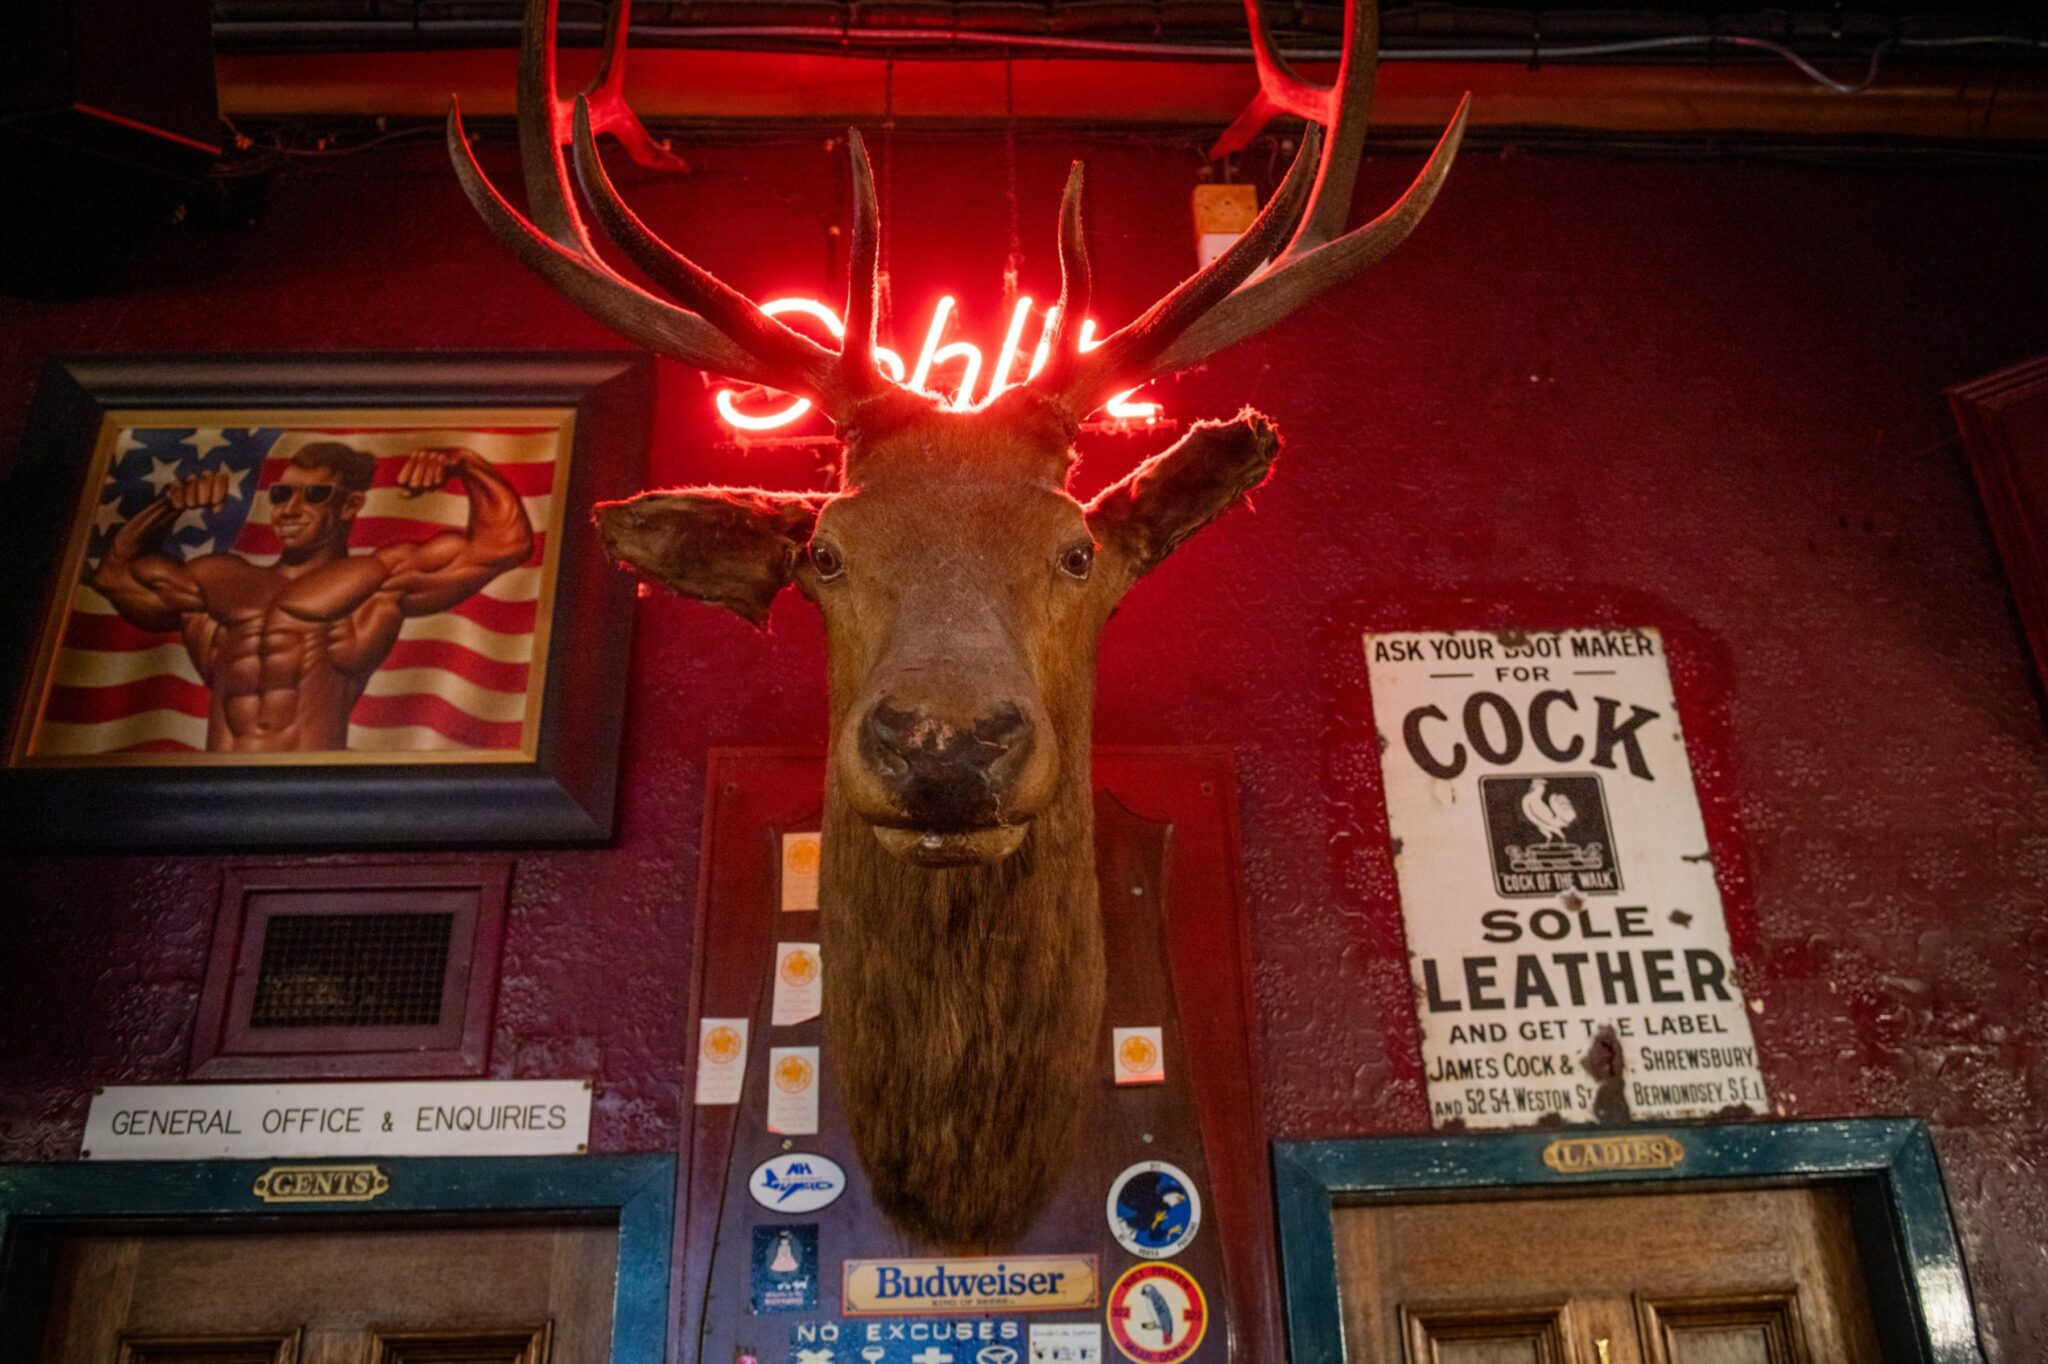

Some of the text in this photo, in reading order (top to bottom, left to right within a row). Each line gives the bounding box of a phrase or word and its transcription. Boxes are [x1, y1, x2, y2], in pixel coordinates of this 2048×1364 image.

[1375, 639, 1424, 662] ASK
[1429, 638, 1494, 661] YOUR
[1571, 636, 1655, 659] MAKER
[1496, 666, 1550, 682] FOR
[1403, 689, 1660, 781] COCK
[1537, 873, 1552, 890] OF
[1481, 907, 1653, 943] SOLE
[1422, 949, 1734, 1013] LEATHER
[1449, 1014, 1728, 1045] AND GET TE LABEL
[1429, 1056, 1499, 1082] JAMES
[1503, 1052, 1555, 1078] COCK
[1560, 1055, 1574, 1075] &
[1435, 1100, 1463, 1117] AND
[1513, 1087, 1572, 1113] WESTON
[111, 1105, 566, 1136] GENERAL OFFICE & ENQUIRIES
[1562, 1143, 1667, 1167] LADIES
[272, 1171, 371, 1195] GENTS
[875, 1264, 1063, 1299] Budweiser
[797, 1323, 839, 1342] NO
[866, 1322, 1019, 1341] EXCUSES
